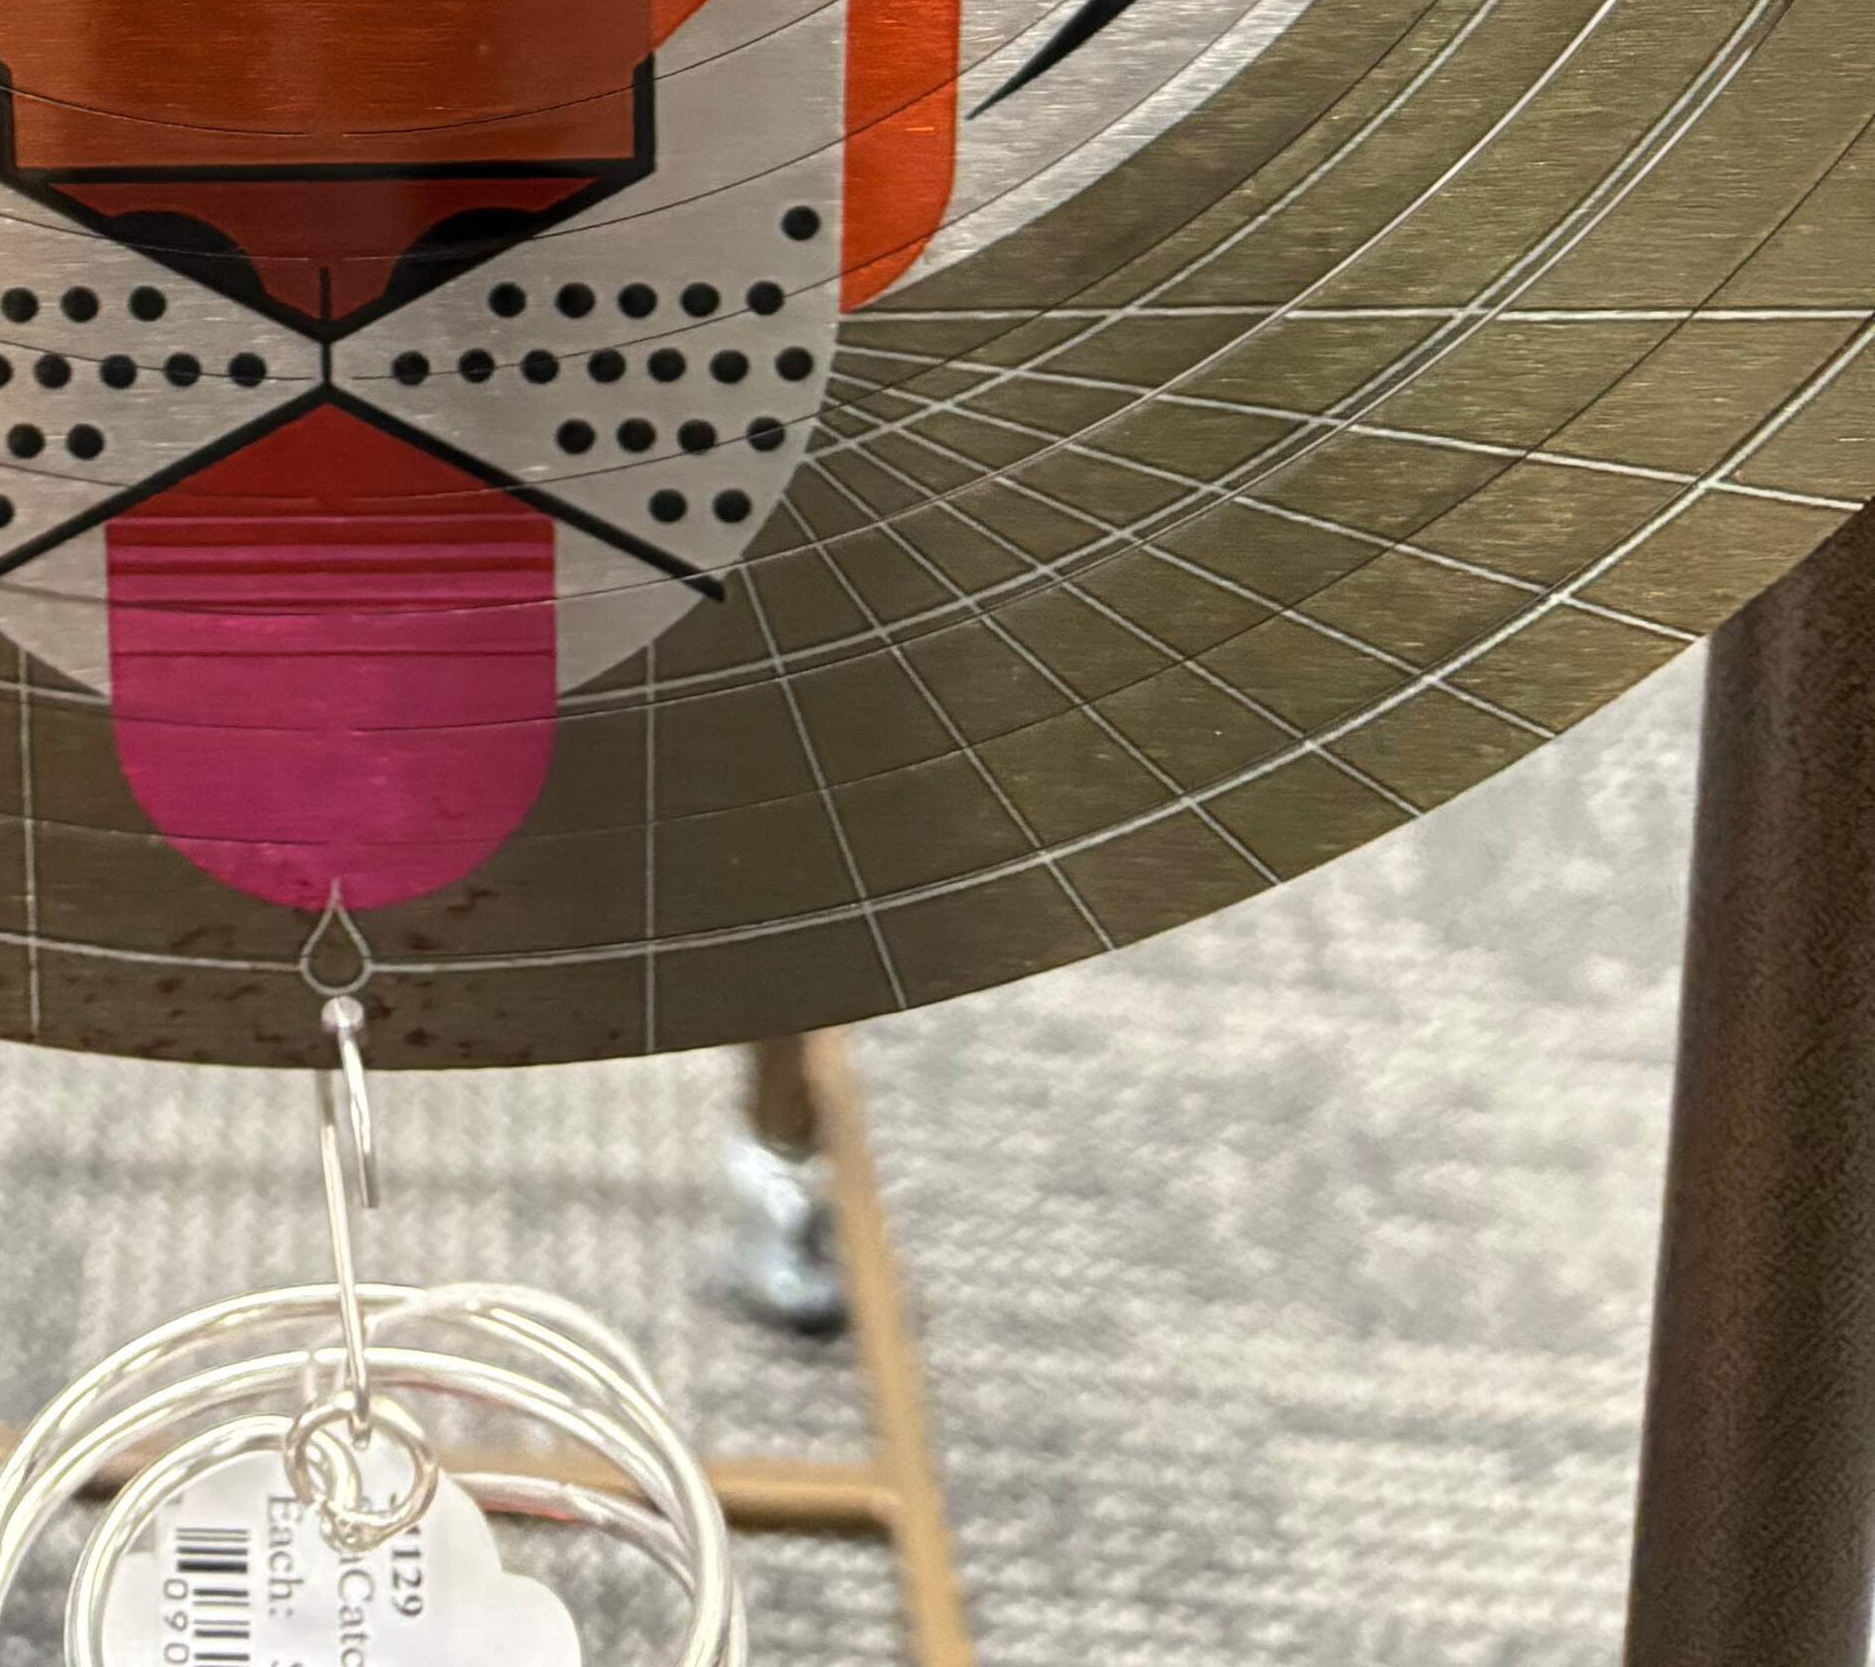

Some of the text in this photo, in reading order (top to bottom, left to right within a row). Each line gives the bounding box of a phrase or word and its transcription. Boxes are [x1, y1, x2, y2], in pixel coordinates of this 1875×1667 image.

[267, 1494, 305, 1618] Each:
[390, 1524, 424, 1618] 129
[162, 1578, 190, 1665] 090
